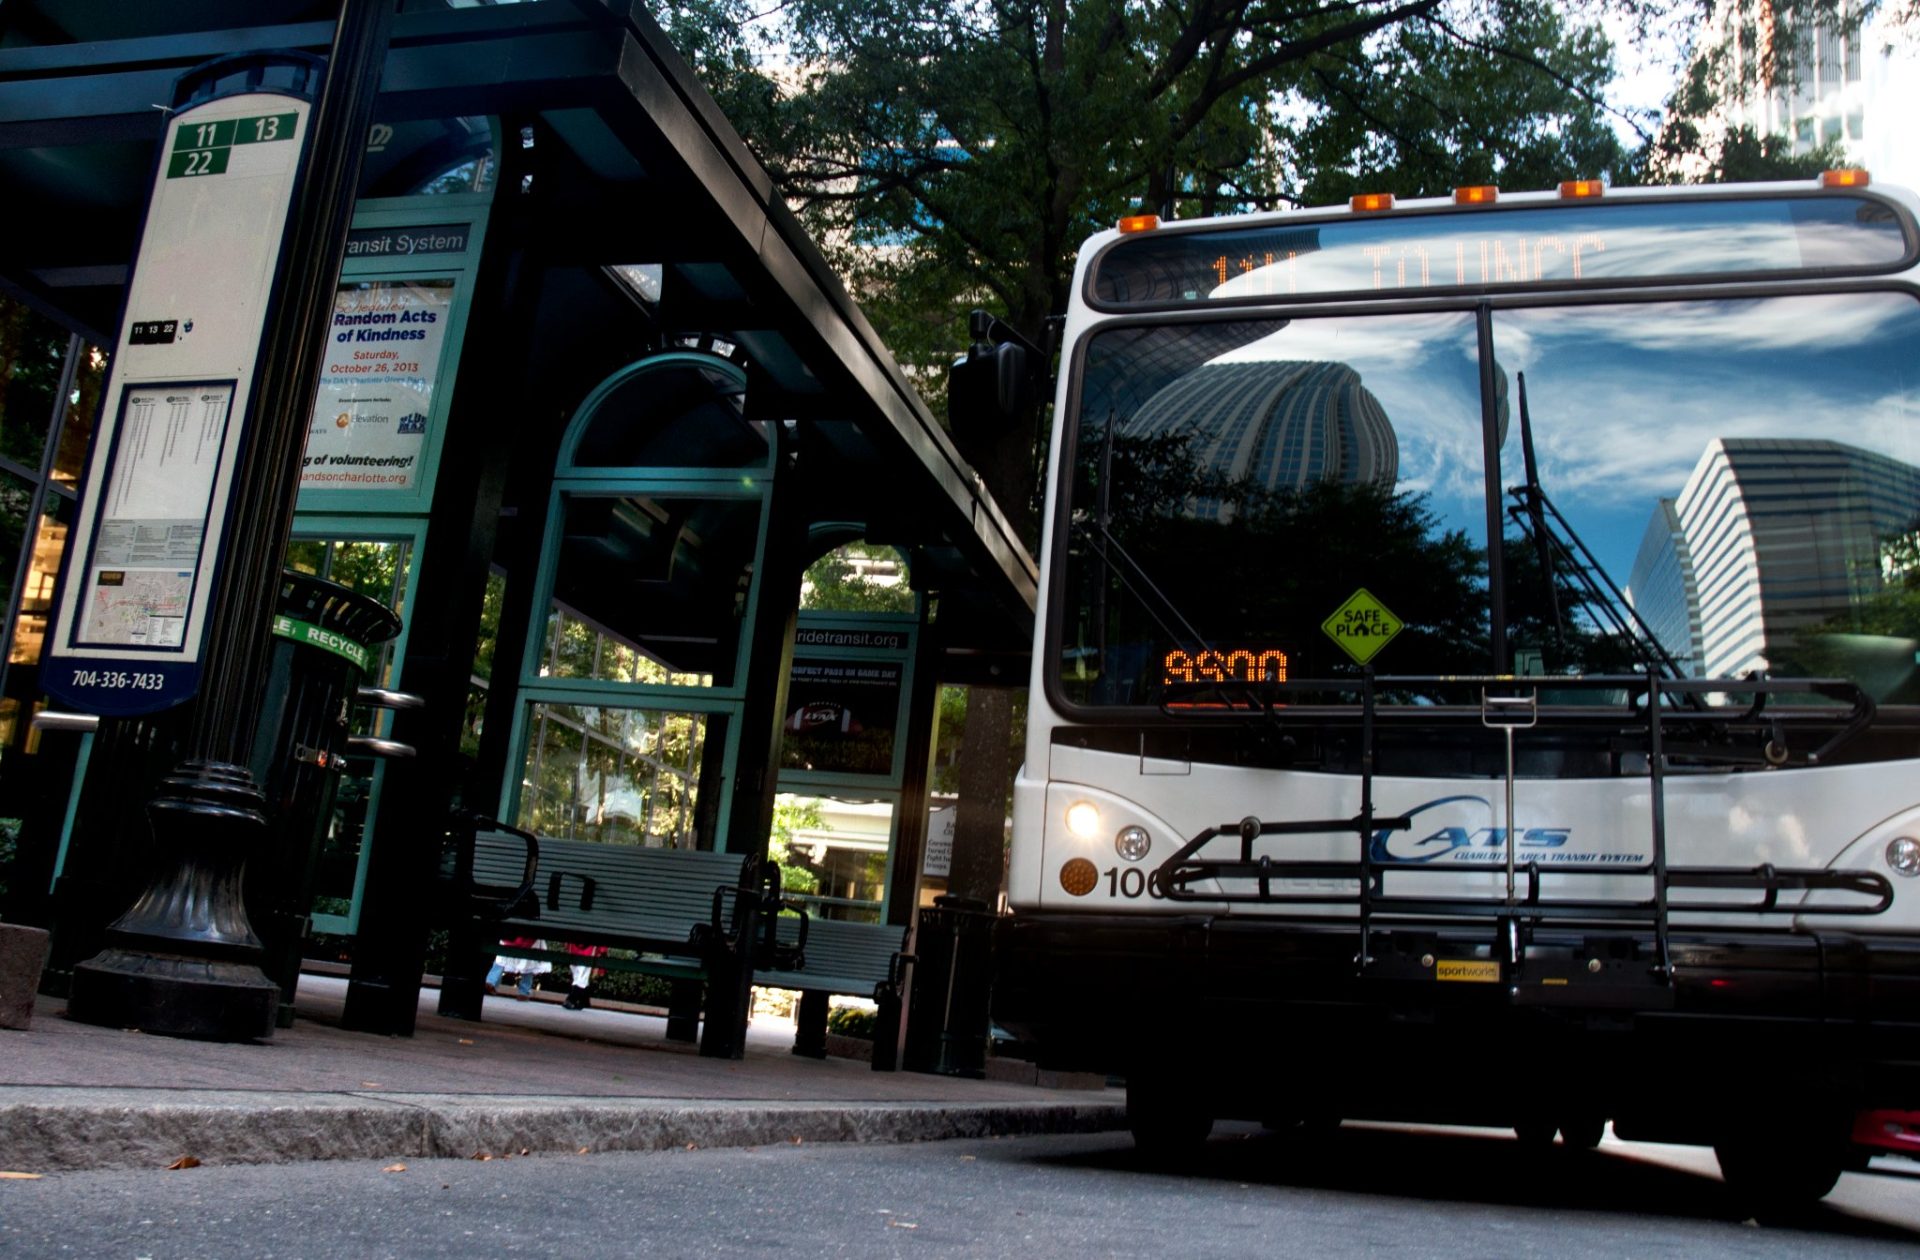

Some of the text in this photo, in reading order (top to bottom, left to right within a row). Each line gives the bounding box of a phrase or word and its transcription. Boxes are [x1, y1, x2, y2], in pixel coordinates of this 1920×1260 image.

[197, 124, 217, 147] 11
[255, 117, 279, 141] 13
[184, 151, 212, 176] 22
[347, 235, 463, 255] ansit System
[334, 310, 437, 326] Random Acts
[135, 324, 174, 334] 11 13 22
[337, 328, 426, 342] of Kindness
[353, 350, 399, 361] Saturday,
[331, 363, 418, 374] October 26, 2013
[352, 412, 389, 424] Elevation
[314, 455, 328, 466] of
[330, 454, 413, 468] volunteering!
[1344, 609, 1381, 623] SAFE
[308, 627, 364, 661] RECYCLE
[797, 630, 899, 648] ridetransit.org
[72, 670, 164, 690] 704-336-7433
[1550, 853, 1596, 862] TRANSIT
[1600, 853, 1644, 862] SYSTEM
[1438, 966, 1497, 977] sportworks
